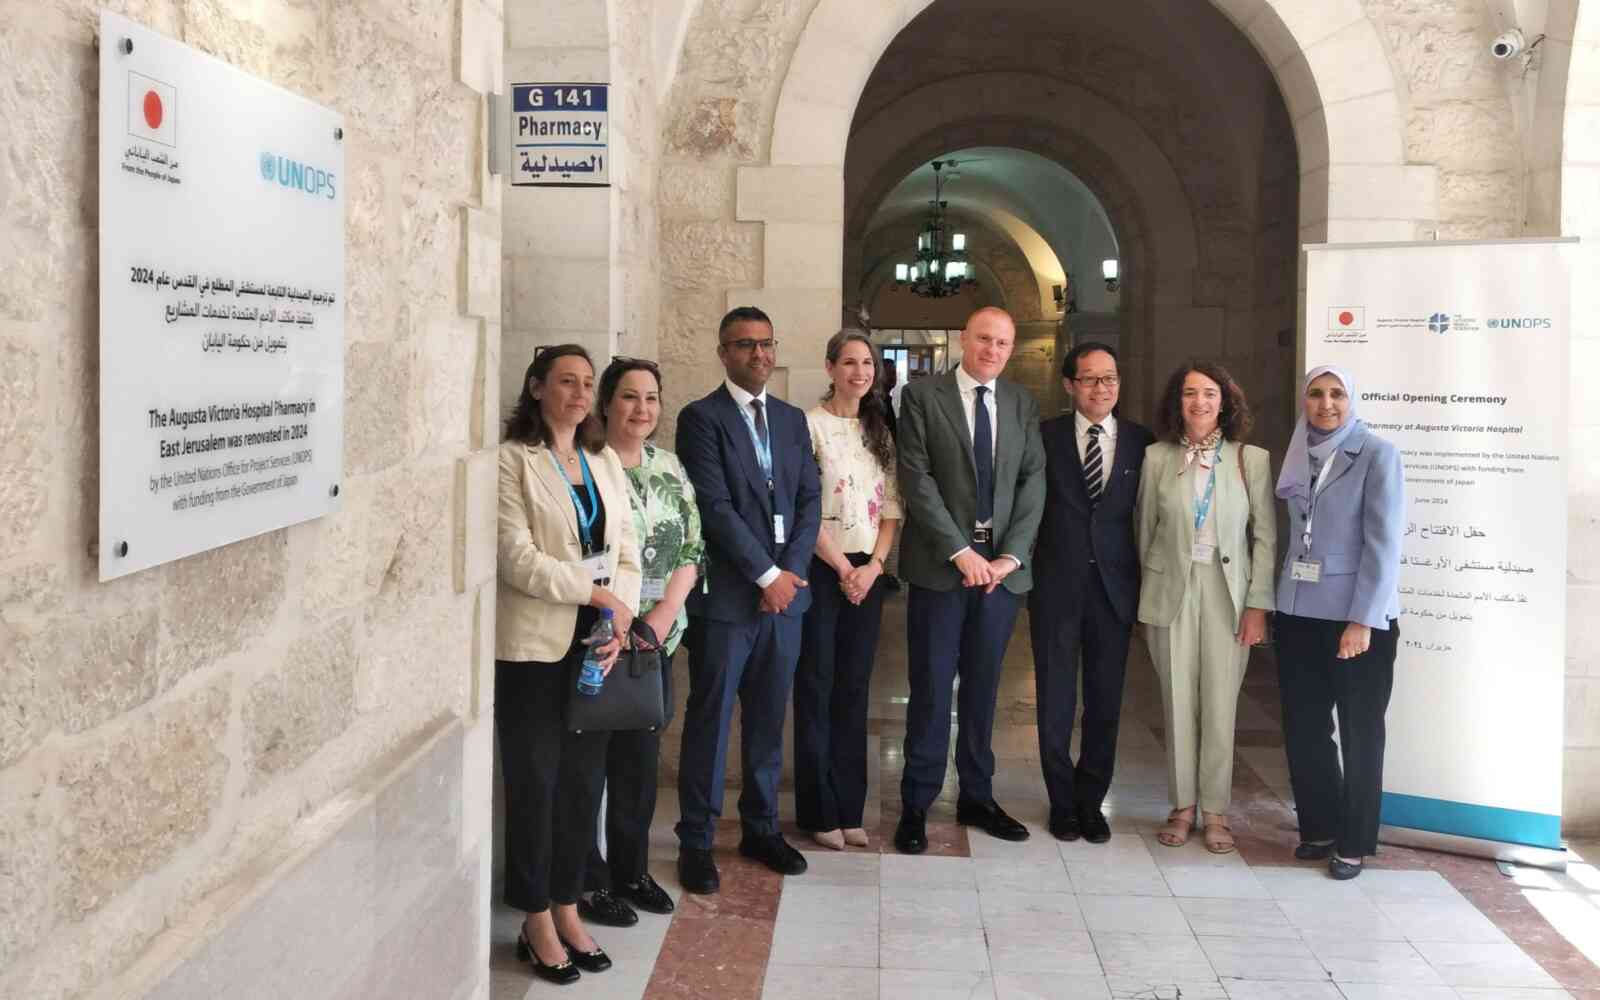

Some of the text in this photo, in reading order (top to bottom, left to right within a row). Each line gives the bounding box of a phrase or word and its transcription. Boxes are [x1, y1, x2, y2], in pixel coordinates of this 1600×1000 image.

[528, 88, 592, 107] G 141
[518, 115, 603, 141] Pharmacy
[519, 151, 603, 179] الصيدلية
[279, 156, 335, 200] UNOPS
[130, 266, 154, 284] 2024
[156, 271, 171, 291] عام
[171, 274, 198, 290] القدس
[199, 277, 210, 298] في
[211, 278, 234, 296] المطلع
[164, 300, 200, 324] المشاريع
[1500, 317, 1552, 330] UNOPS
[201, 332, 227, 353] اليابان
[228, 333, 251, 352] حكومة
[252, 337, 264, 352] من
[1361, 392, 1508, 406] Official Opening Ceremony
[148, 399, 317, 430] The Augusta Victoria Hospital Pharmacy in
[1404, 423, 1416, 432] at
[1416, 423, 1449, 434] Augusta
[1451, 425, 1484, 434] Victoria
[1486, 425, 1523, 435] Hospital
[160, 439, 181, 458] East
[181, 432, 226, 455] Jerusalem
[227, 434, 243, 449] was
[244, 427, 282, 446] renovated
[290, 423, 308, 440] 2024
[149, 474, 160, 494] by
[160, 471, 172, 488] the
[173, 466, 197, 487] United
[198, 466, 222, 481] Nations
[222, 460, 241, 477] Office
[249, 457, 272, 474] Project
[1455, 479, 1475, 487] Japan
[172, 493, 188, 511] with
[188, 489, 215, 508] funding
[241, 477, 273, 496] Government
[1463, 525, 1486, 538] حفل
[1497, 560, 1534, 575] صيدلية
